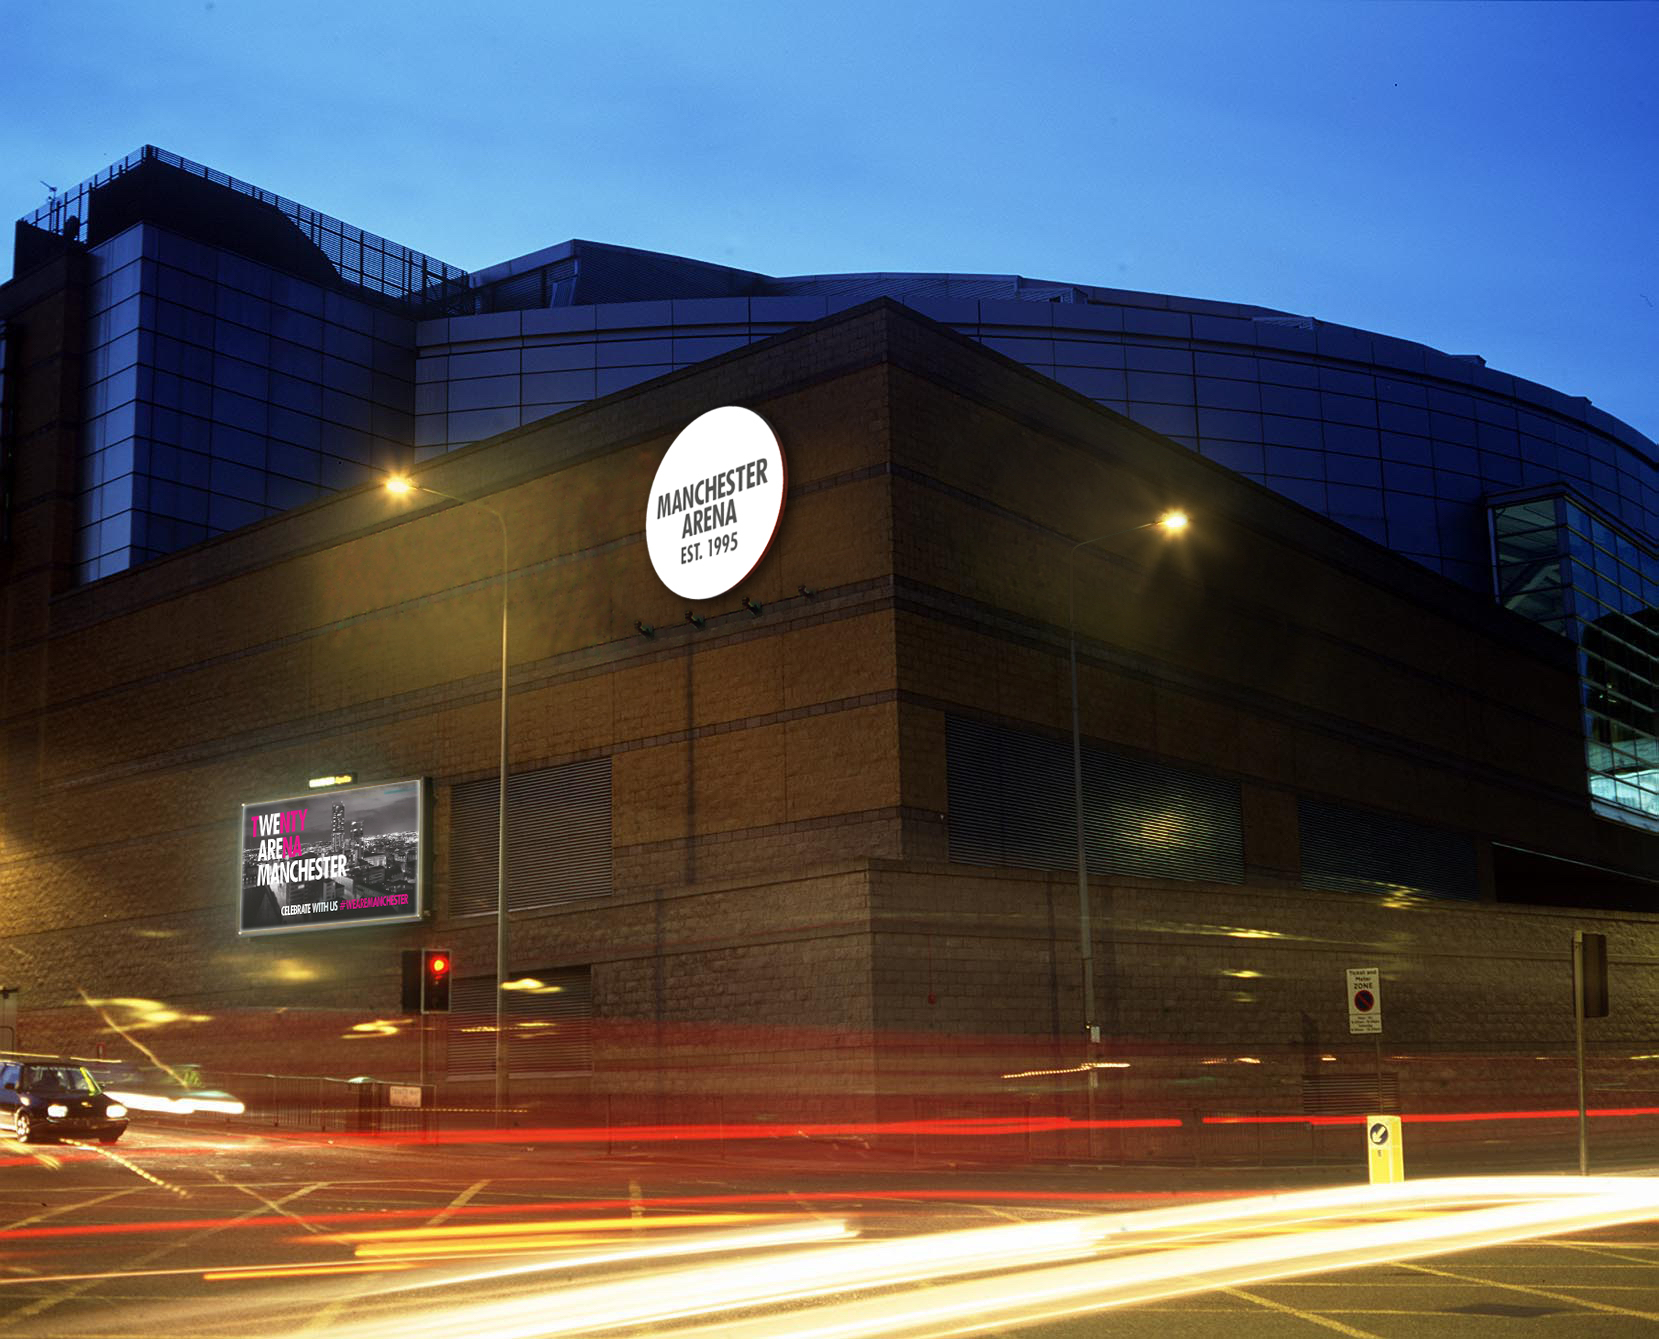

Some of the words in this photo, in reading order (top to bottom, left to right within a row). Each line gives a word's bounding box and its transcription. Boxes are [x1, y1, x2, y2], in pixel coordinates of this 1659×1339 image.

[657, 458, 768, 519] MANCHESTER
[682, 499, 737, 539] ARENA
[681, 542, 702, 564] EST.
[708, 532, 738, 557] 1995
[251, 809, 308, 838] TWENTY
[258, 835, 302, 862] ARENA
[256, 854, 347, 886] MANCHESTER
[281, 903, 311, 916] CELEBRATE
[312, 901, 329, 913] WITH
[330, 900, 338, 912] US
[339, 894, 409, 911] #WEAREMANCHESTER
